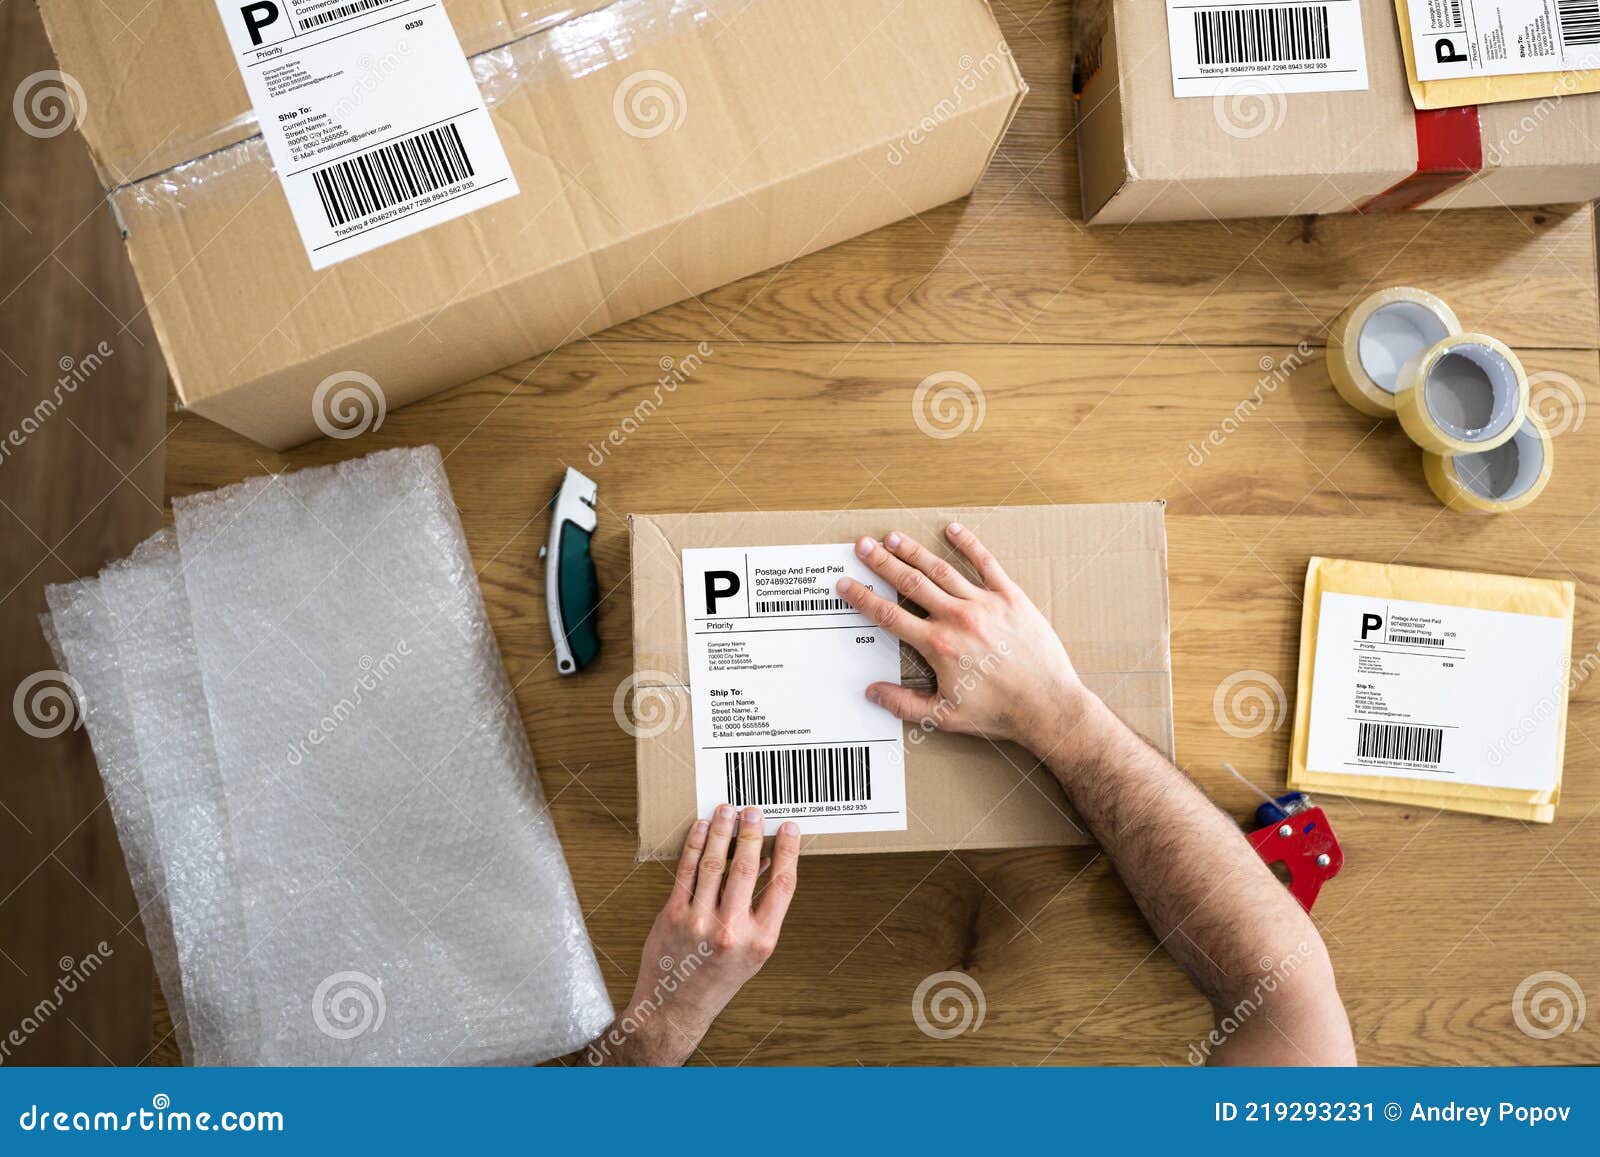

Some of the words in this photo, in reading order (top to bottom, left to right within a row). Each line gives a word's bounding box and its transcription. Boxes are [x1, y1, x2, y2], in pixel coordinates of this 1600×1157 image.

[240, 0, 279, 47] P
[404, 19, 424, 31] 0539
[256, 47, 283, 60] Priority
[1435, 38, 1468, 64] P
[278, 111, 298, 122] Ship
[298, 106, 312, 115] To:
[282, 119, 307, 132] Current
[307, 113, 327, 123] Name
[285, 128, 305, 139] Street
[287, 135, 308, 146] 80000
[322, 124, 342, 135] Name
[293, 150, 315, 162] E-Mail:
[317, 123, 392, 154] emailname@server.com
[334, 223, 363, 237] Tracking
[369, 209, 397, 225] 9046279
[397, 203, 413, 214] 8947
[414, 197, 432, 207] 7298
[431, 190, 449, 201] 8943
[448, 185, 461, 195] 582
[461, 181, 475, 190] 935
[755, 568, 787, 576] Postage
[788, 567, 803, 575] And
[805, 566, 825, 574] Feed
[827, 565, 844, 573] Paid
[755, 576, 817, 586] 9074893276897
[704, 570, 741, 615] P
[756, 588, 802, 597] Commercial
[803, 587, 830, 595] Pricing
[706, 622, 734, 630] Priority
[1361, 613, 1383, 640] P
[856, 636, 875, 644] 0539
[710, 689, 729, 698] Ship
[730, 688, 743, 696] To:
[711, 715, 732, 723] 80000
[736, 729, 811, 737] emailname@server.com
[763, 807, 790, 815] 9046279
